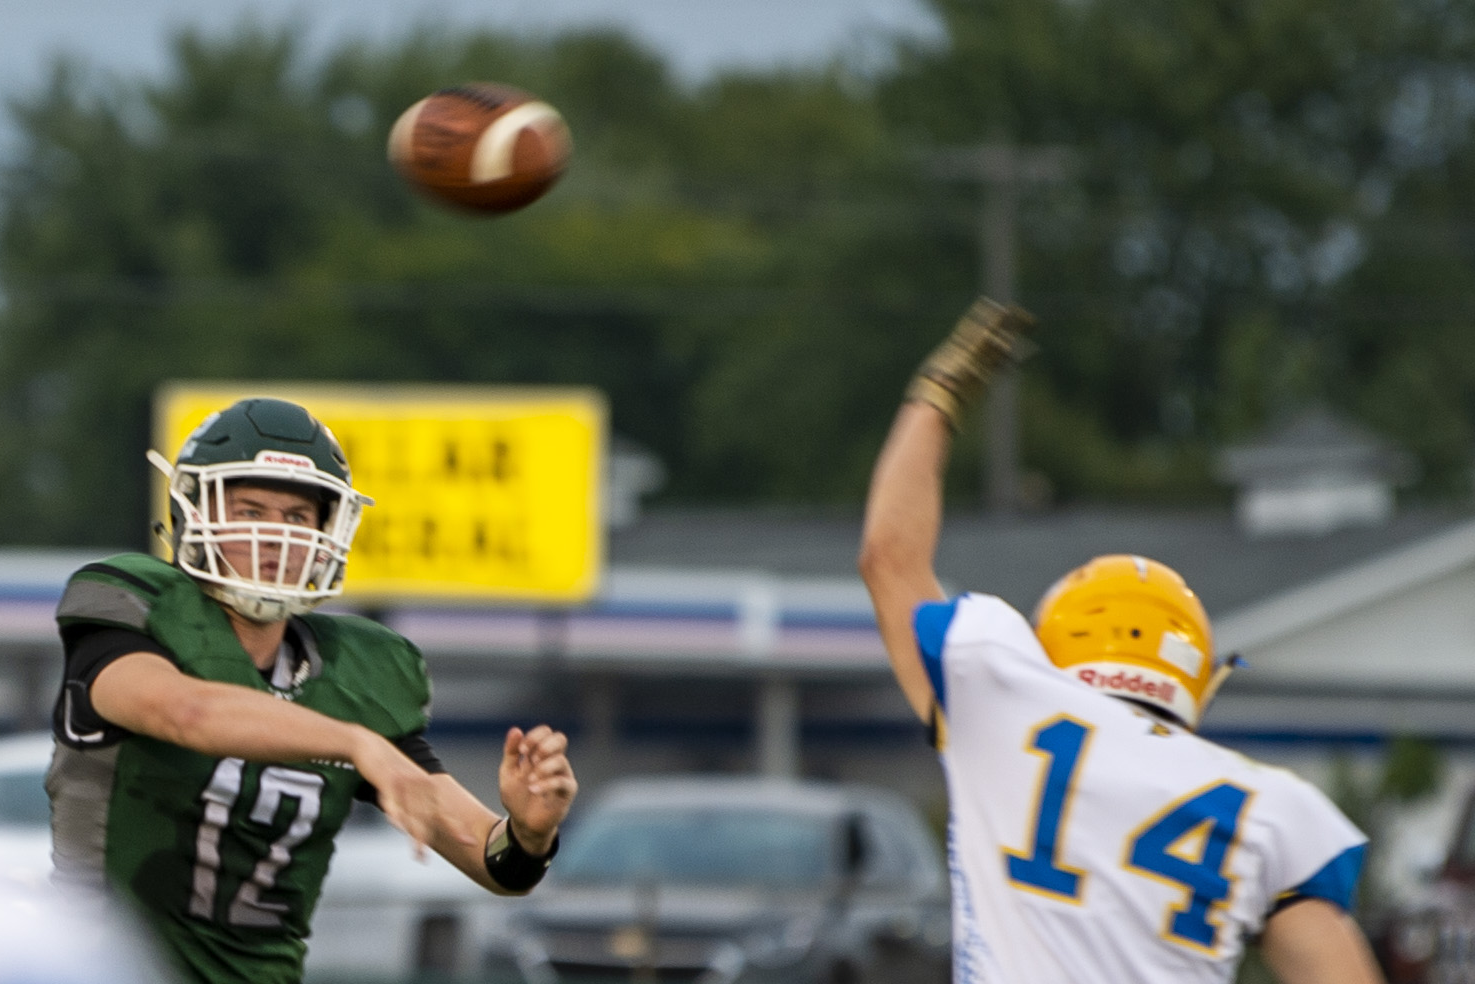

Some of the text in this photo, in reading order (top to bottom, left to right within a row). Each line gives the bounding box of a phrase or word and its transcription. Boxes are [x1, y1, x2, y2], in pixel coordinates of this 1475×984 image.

[1077, 669, 1176, 704] Riddell
[188, 757, 325, 927] 12
[999, 712, 1257, 957] 14
